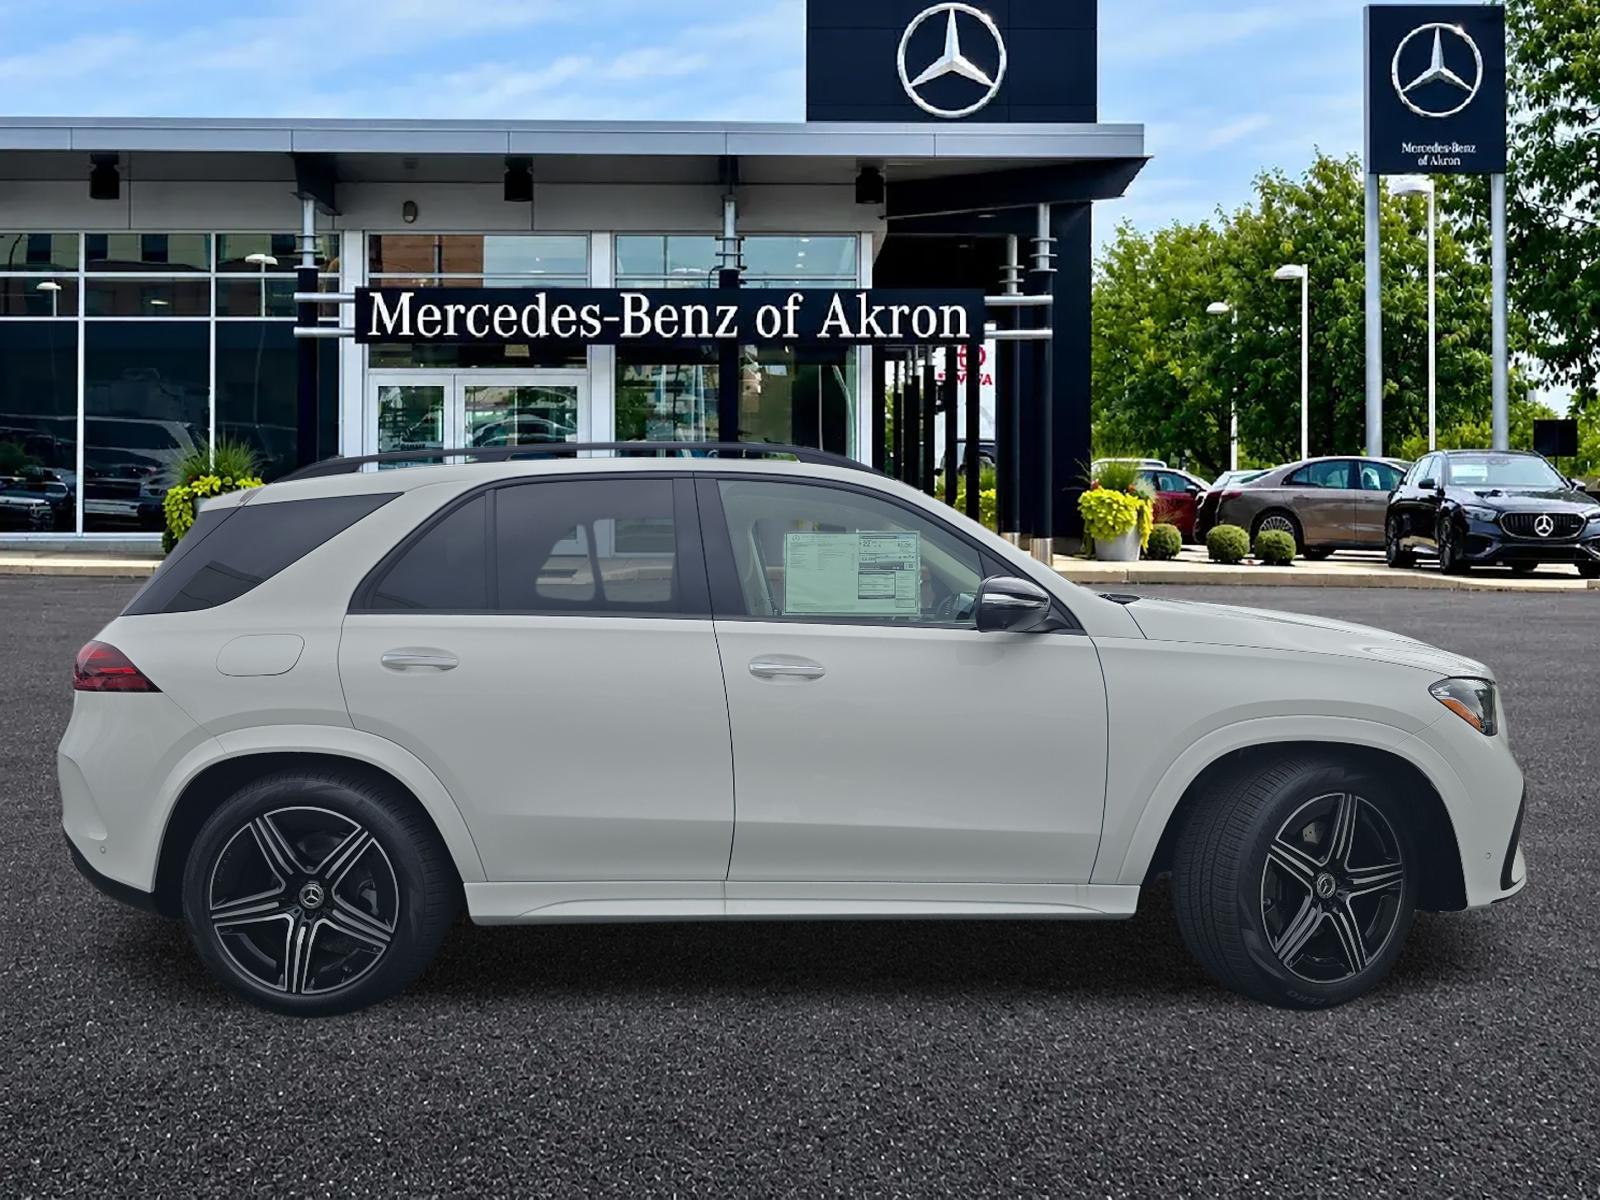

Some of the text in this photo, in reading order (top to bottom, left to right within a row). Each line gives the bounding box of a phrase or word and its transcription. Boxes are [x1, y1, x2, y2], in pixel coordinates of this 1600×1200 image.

[1401, 142, 1477, 154] Mercedes-Benz
[1417, 155, 1461, 166] of Akron
[367, 292, 970, 338] Mercedes-Benz of Akron
